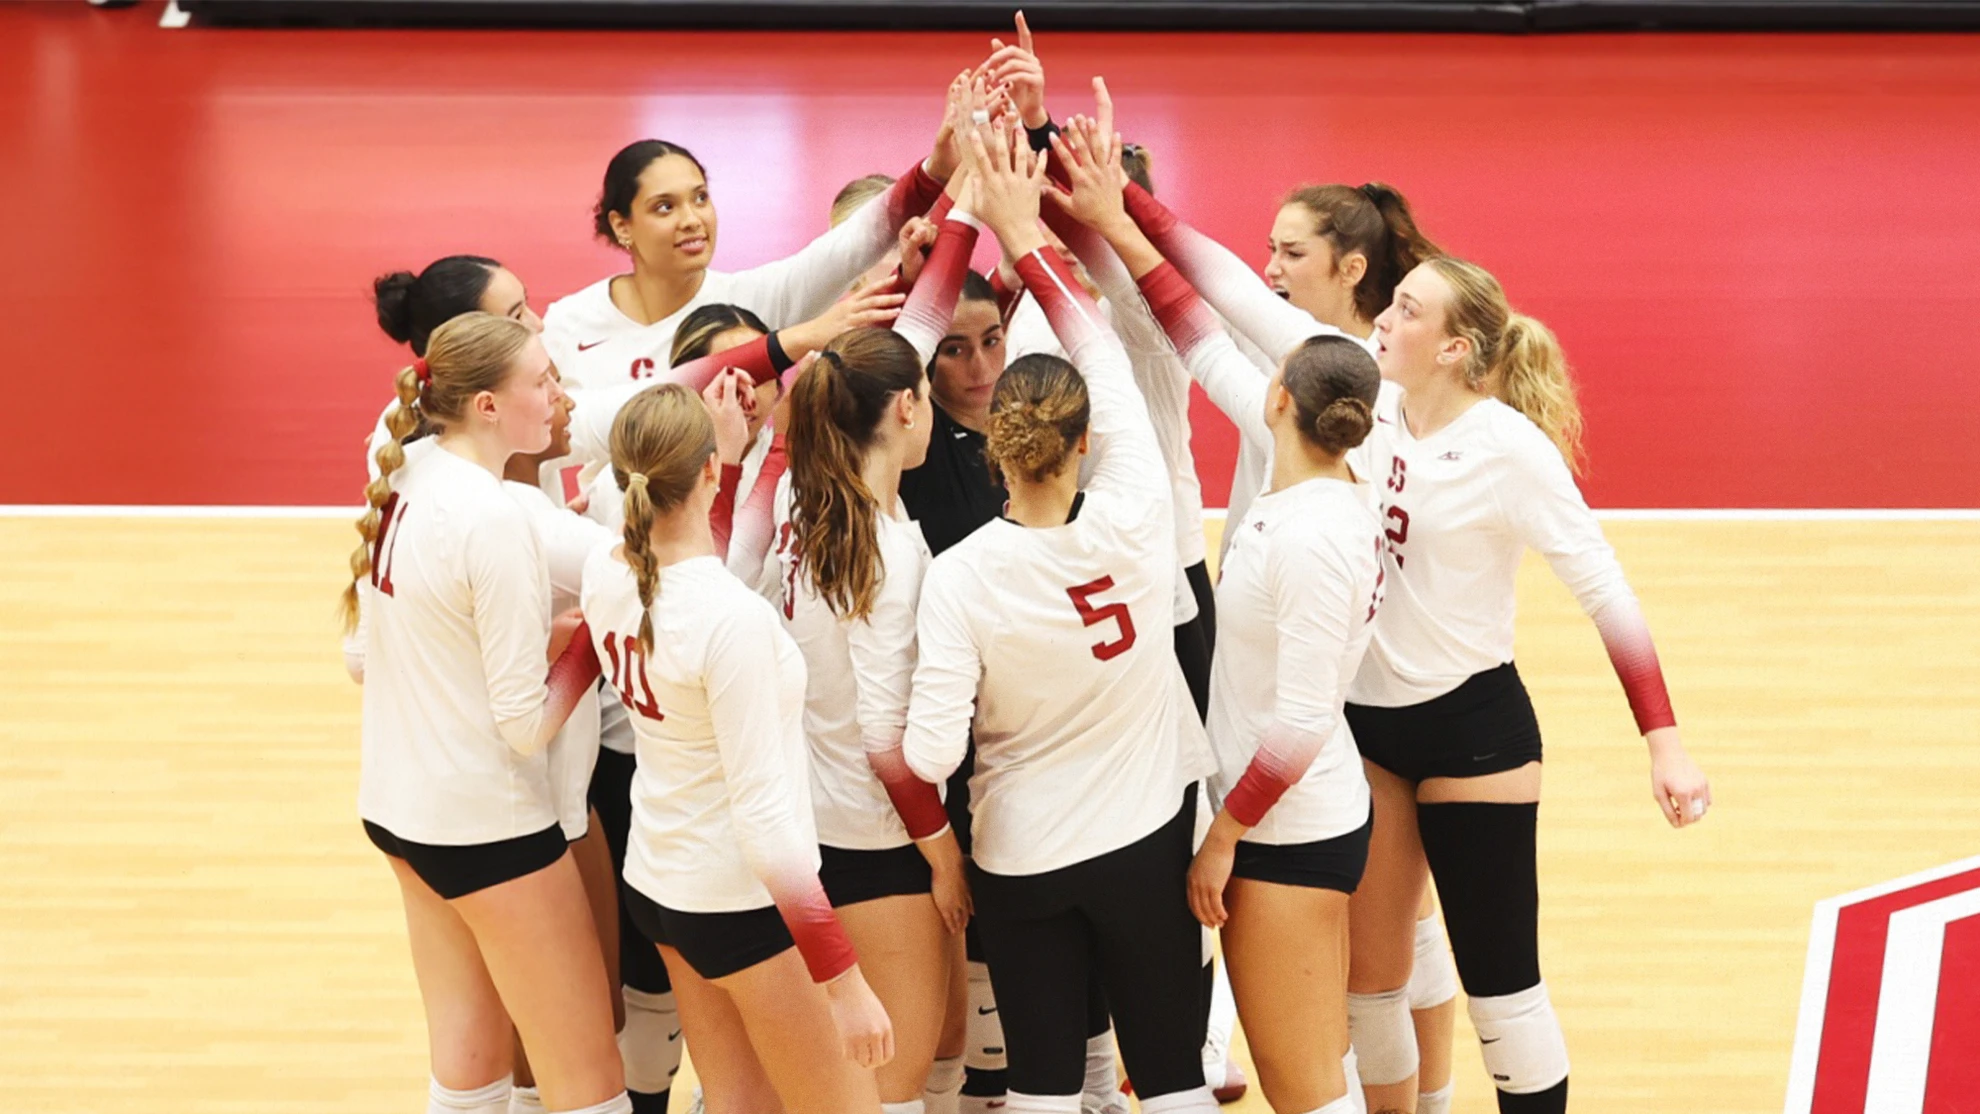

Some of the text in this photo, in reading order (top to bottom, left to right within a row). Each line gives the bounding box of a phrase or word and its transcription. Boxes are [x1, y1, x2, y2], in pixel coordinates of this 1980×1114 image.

[1379, 502, 1409, 570] 2
[1065, 574, 1136, 661] 5
[603, 631, 665, 722] 10
